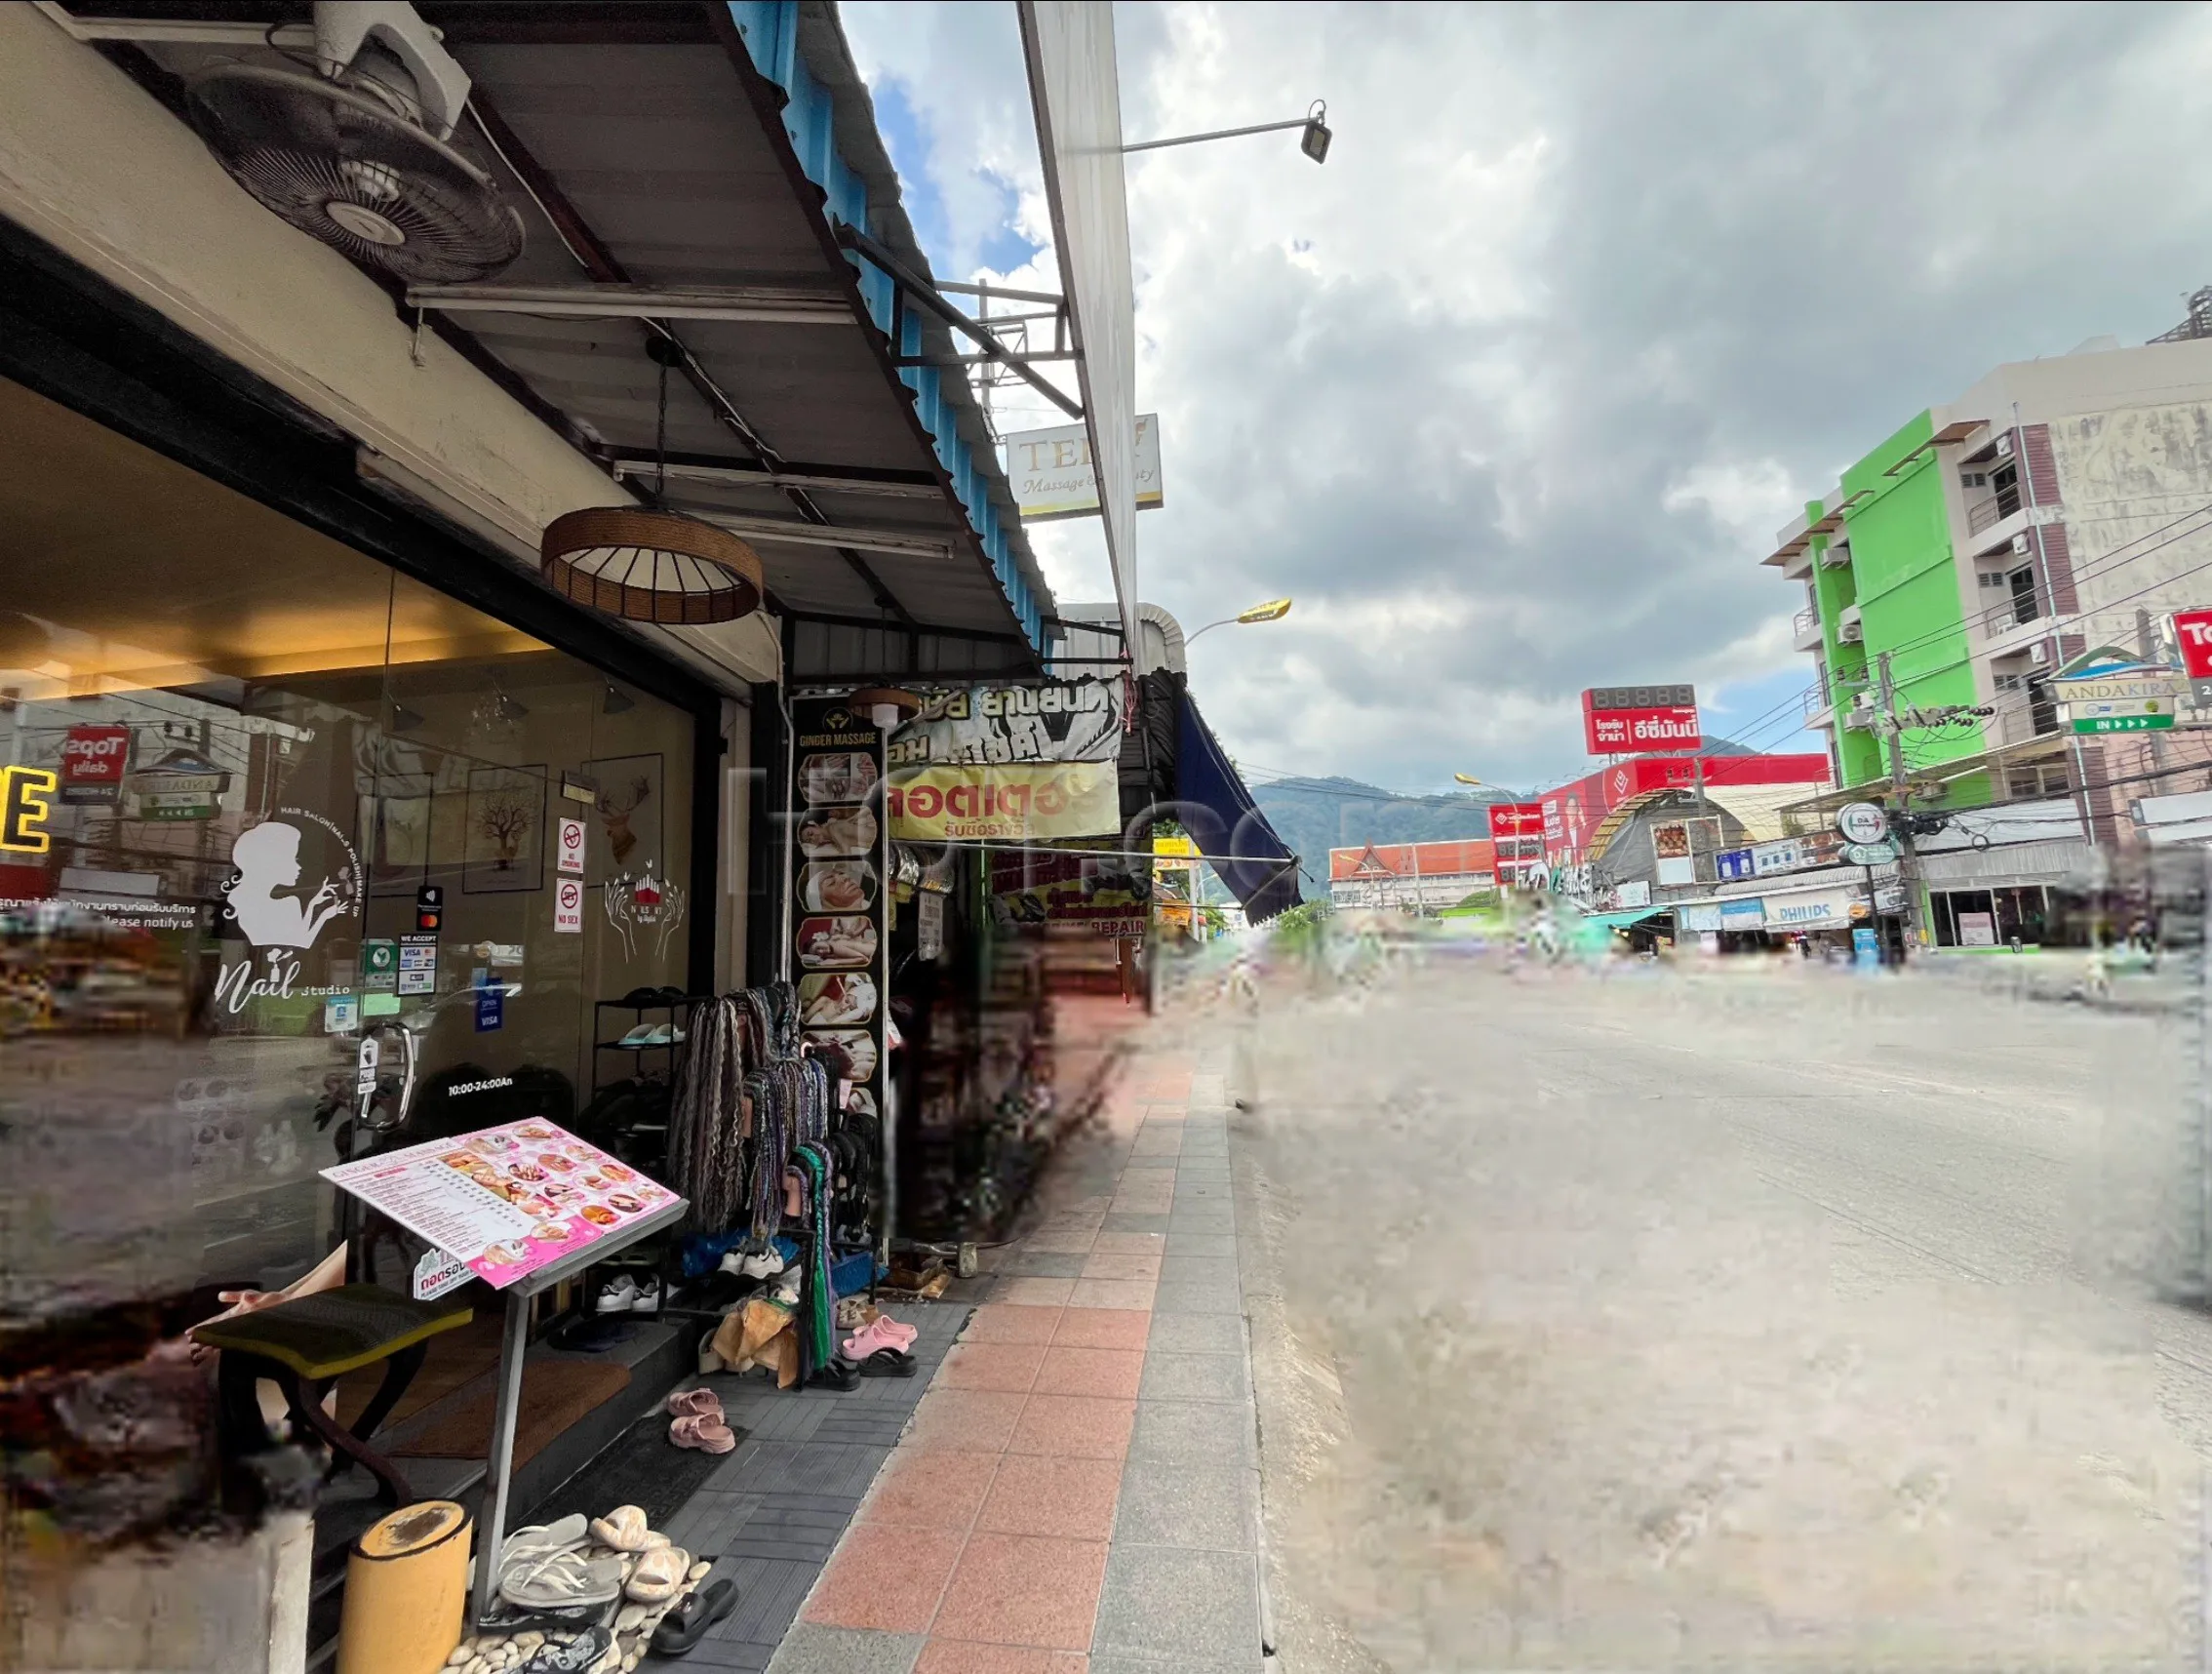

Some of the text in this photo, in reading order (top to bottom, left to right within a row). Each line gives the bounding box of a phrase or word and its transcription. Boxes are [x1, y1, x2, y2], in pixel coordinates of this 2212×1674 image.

[1023, 477, 1084, 495] Massage
[2066, 682, 2178, 699] ANDAKIRA
[2096, 720, 2111, 730] IN
[800, 732, 876, 746] GINGER MASSAGE
[144, 917, 178, 931] notify
[558, 914, 578, 925] NO SEX
[404, 948, 420, 957] VISA
[215, 960, 300, 1014] Nail
[481, 1016, 497, 1026] VISA
